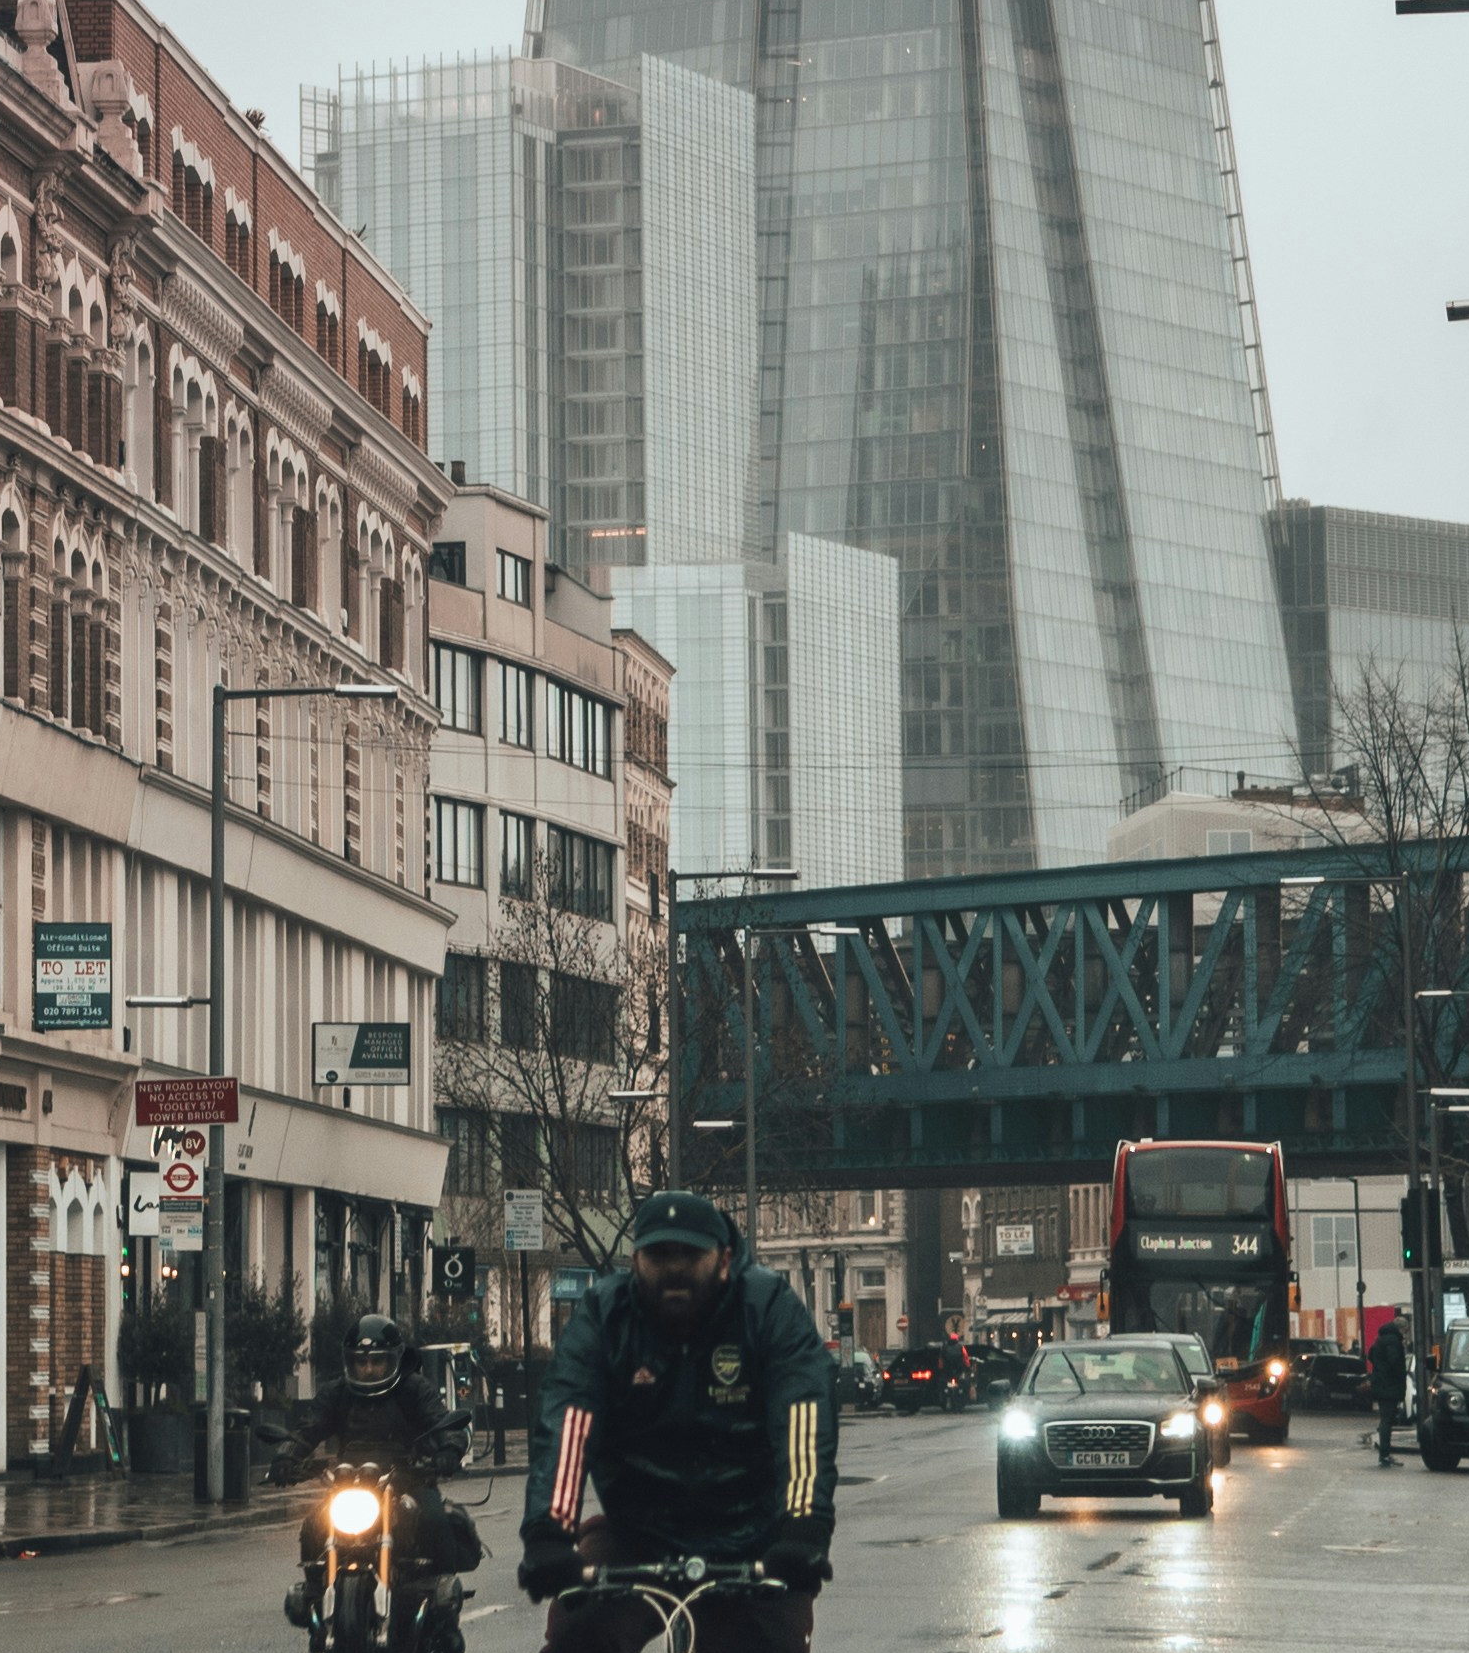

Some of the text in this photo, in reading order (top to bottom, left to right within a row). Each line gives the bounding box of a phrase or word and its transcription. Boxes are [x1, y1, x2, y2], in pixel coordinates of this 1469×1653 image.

[40, 933, 107, 942] Air-conditioned
[47, 944, 101, 952] Office Suite
[41, 961, 106, 975] TO LET
[44, 1007, 102, 1016] 020 7891 2345
[368, 1031, 403, 1039] BESPOKE
[139, 1080, 234, 1093] NEW ROAD LAYOUT
[149, 1090, 224, 1103] NO ACCESS TO
[159, 1101, 216, 1112] TOOLEY ST/
[149, 1111, 226, 1122] TOWER BRIDGE
[185, 1138, 202, 1150] BV
[1140, 1235, 1258, 1255] Clapham Junction 344
